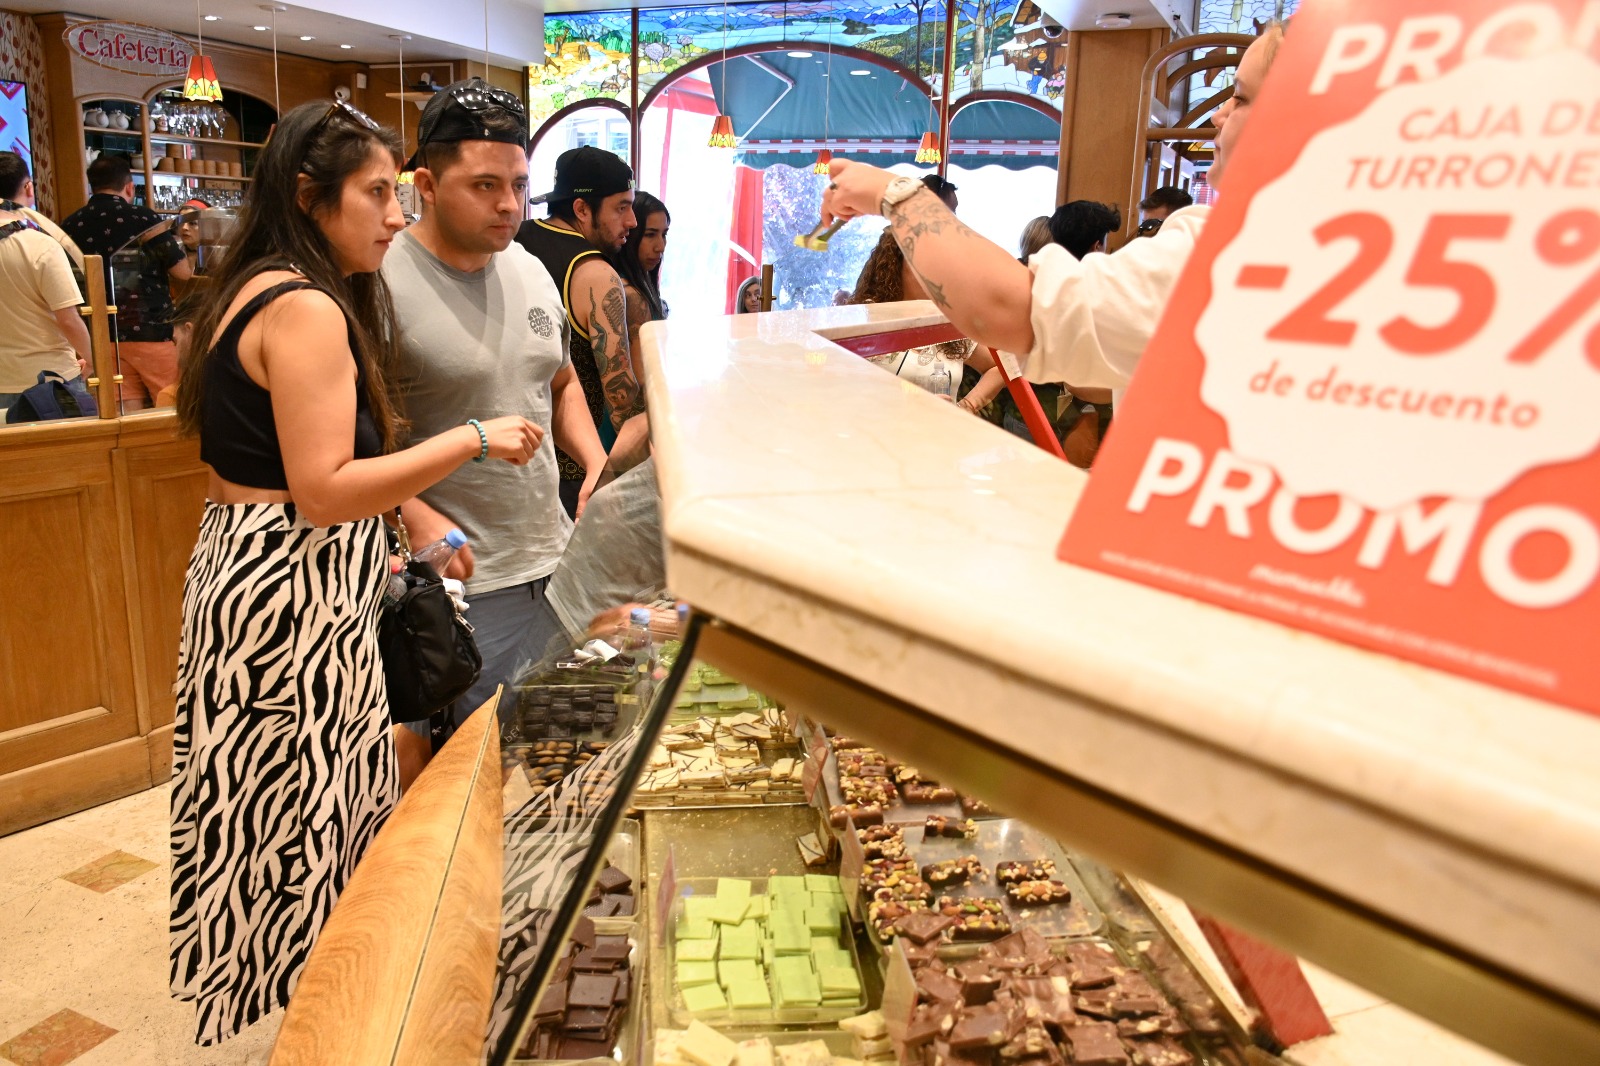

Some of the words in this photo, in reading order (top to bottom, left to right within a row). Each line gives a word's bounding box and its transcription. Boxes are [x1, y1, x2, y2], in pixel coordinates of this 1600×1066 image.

[1307, 0, 1600, 95] PRO
[1397, 103, 1522, 143] CAJA
[1344, 148, 1600, 191] TURRONE
[1234, 207, 1600, 374] -25%
[1248, 359, 1295, 397] de
[1304, 364, 1541, 429] descuento
[1126, 436, 1600, 609] PROMO
